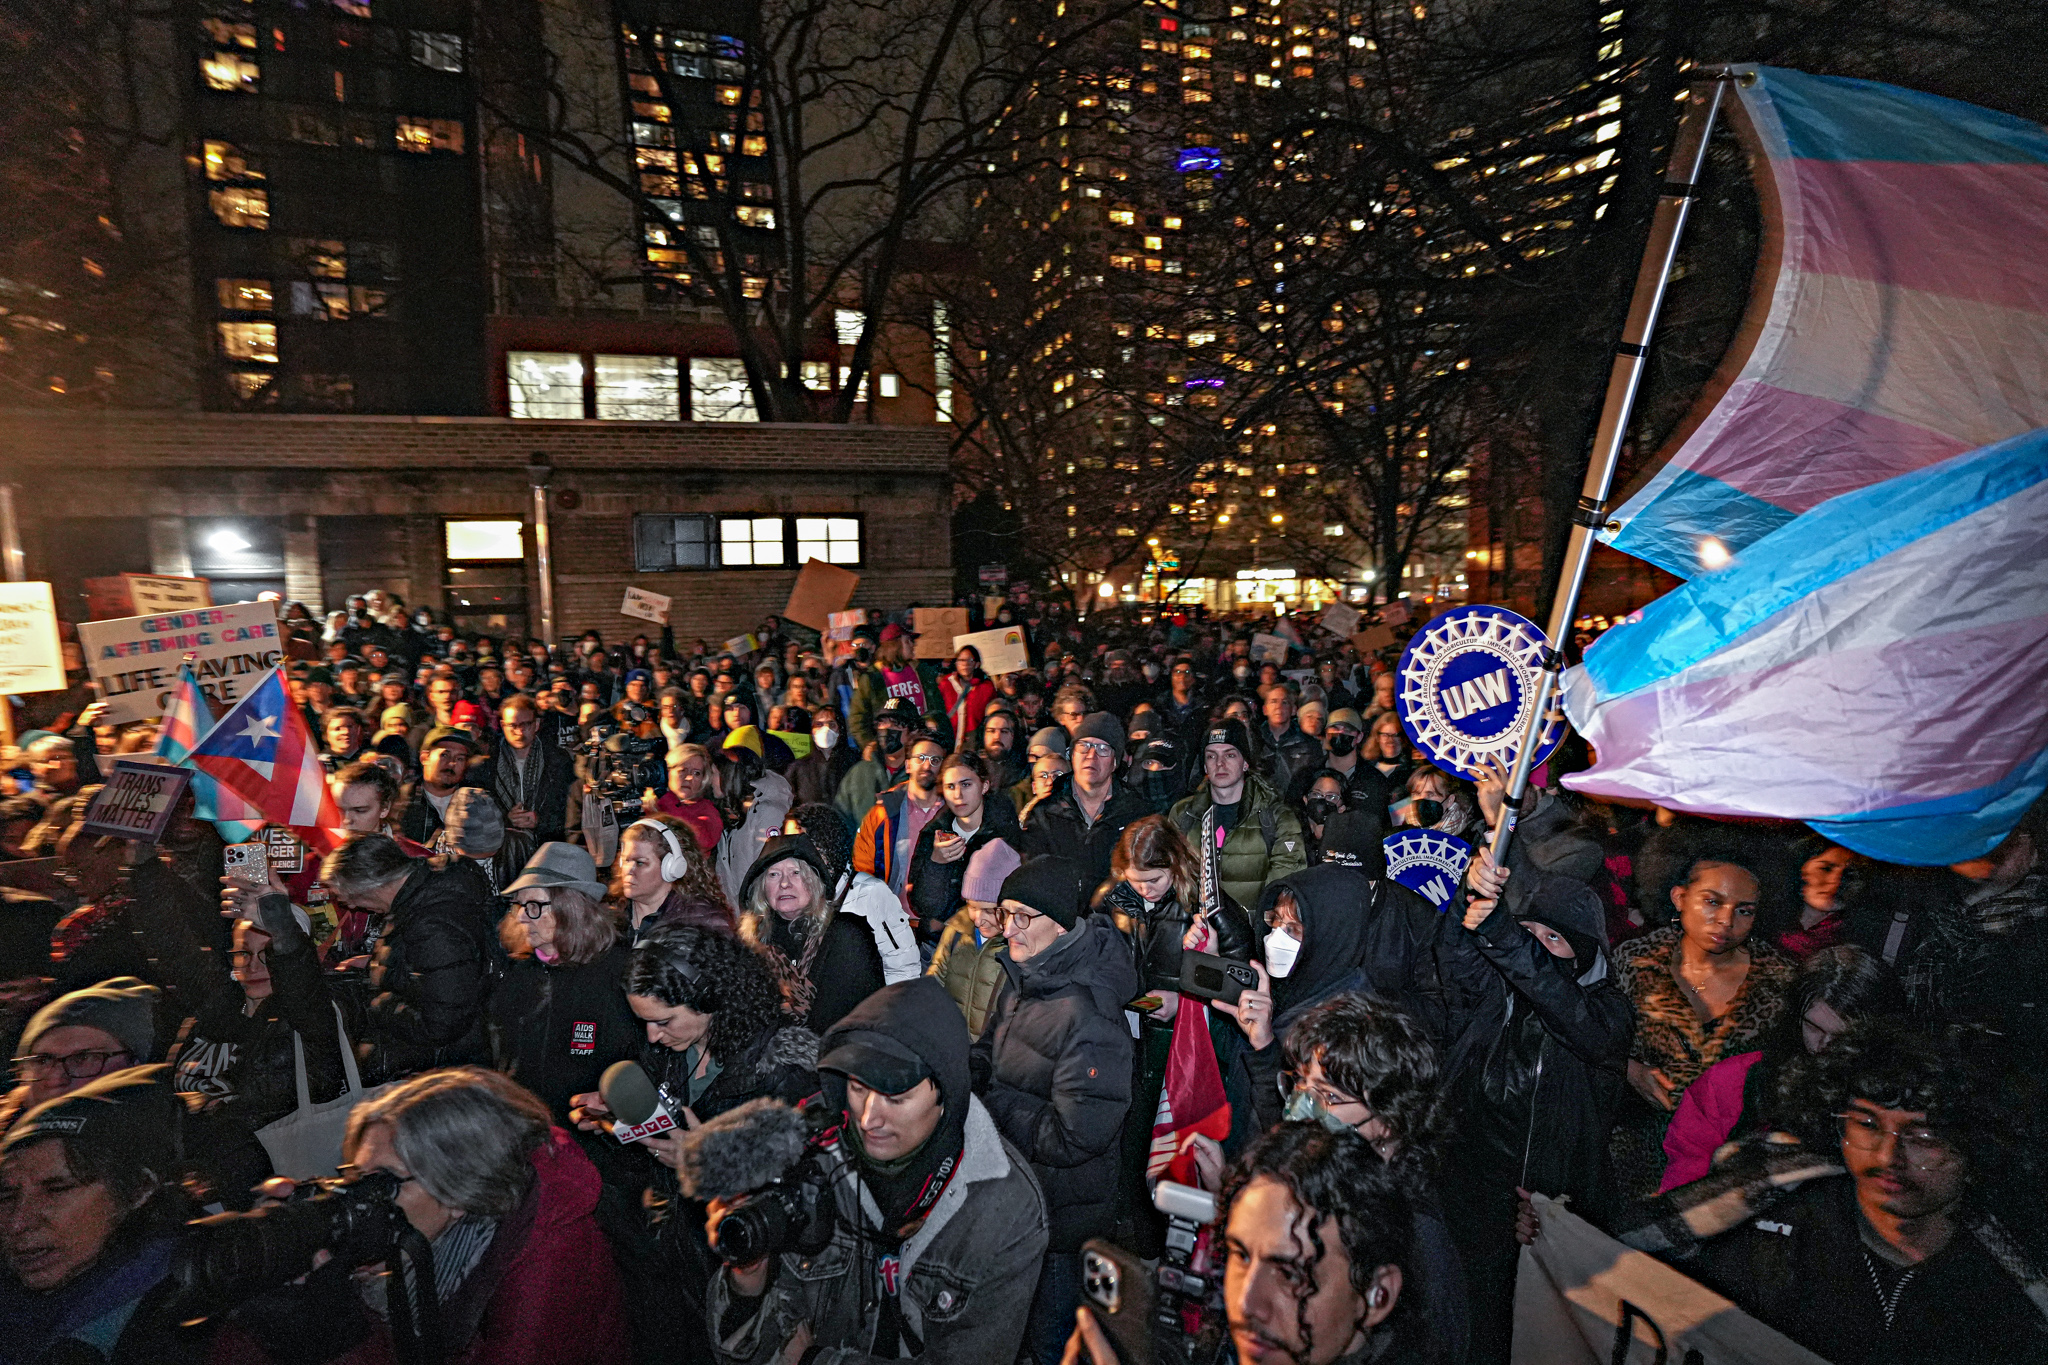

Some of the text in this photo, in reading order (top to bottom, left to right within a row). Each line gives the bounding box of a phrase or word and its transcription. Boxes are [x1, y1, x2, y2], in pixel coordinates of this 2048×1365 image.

[140, 610, 234, 633] GENDER-
[102, 623, 278, 659] AFFIRMING CARE
[1487, 641, 1519, 663] IMPLEMENT
[1433, 653, 1443, 665] AND
[1423, 666, 1434, 699] AEROSPACE
[1518, 664, 1533, 693] WORKERS
[156, 679, 237, 711] CRE
[1440, 668, 1510, 721] UAW
[1527, 696, 1533, 706] OF
[1448, 736, 1470, 749] UNITED
[116, 771, 166, 795] TRANS
[109, 787, 155, 811] LIVES
[92, 803, 156, 830] MATTER
[1423, 854, 1452, 868] IMPLEMENT
[574, 1031, 593, 1039] WALK
[575, 1023, 594, 1032] AIDS
[619, 1118, 670, 1139] WNYC
[919, 1156, 954, 1207] EOS 70D
